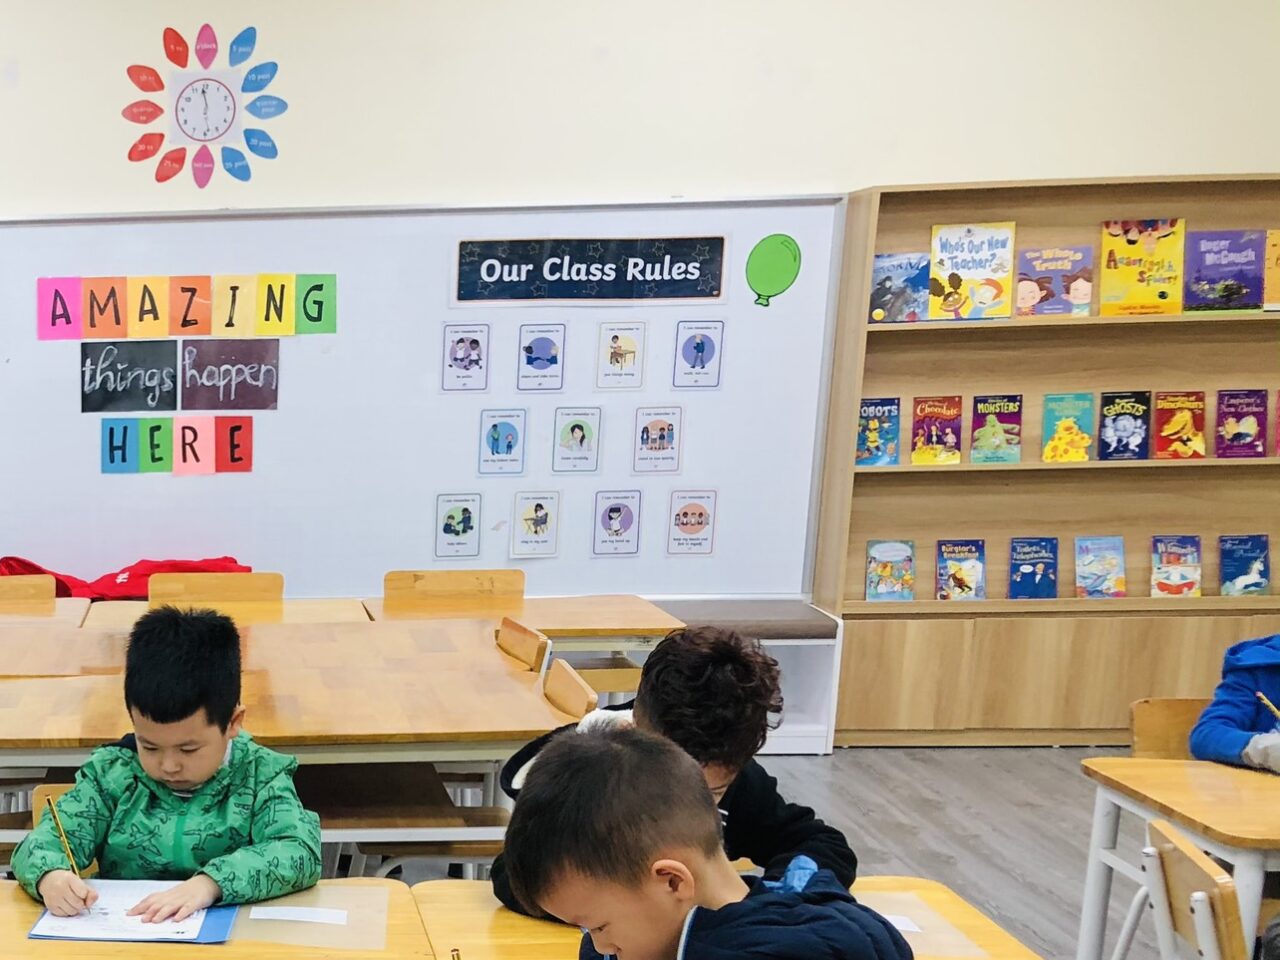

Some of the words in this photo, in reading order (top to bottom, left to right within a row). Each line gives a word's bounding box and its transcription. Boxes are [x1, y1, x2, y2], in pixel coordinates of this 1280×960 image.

[939, 236, 965, 254] Who's
[967, 239, 985, 254] Our
[987, 237, 1009, 251] New
[480, 258, 533, 282] Our
[542, 255, 616, 282] Class
[626, 254, 701, 281] Rules
[947, 252, 997, 271] Teacher?
[51, 284, 324, 328] AMAZING
[82, 346, 174, 407] things
[183, 347, 278, 402] happen
[860, 405, 898, 417] OBOTS
[916, 402, 959, 416] Chocolate
[977, 401, 1020, 414] MONSTERS
[1103, 402, 1147, 417] GHOSTS
[108, 424, 243, 464] HERE
